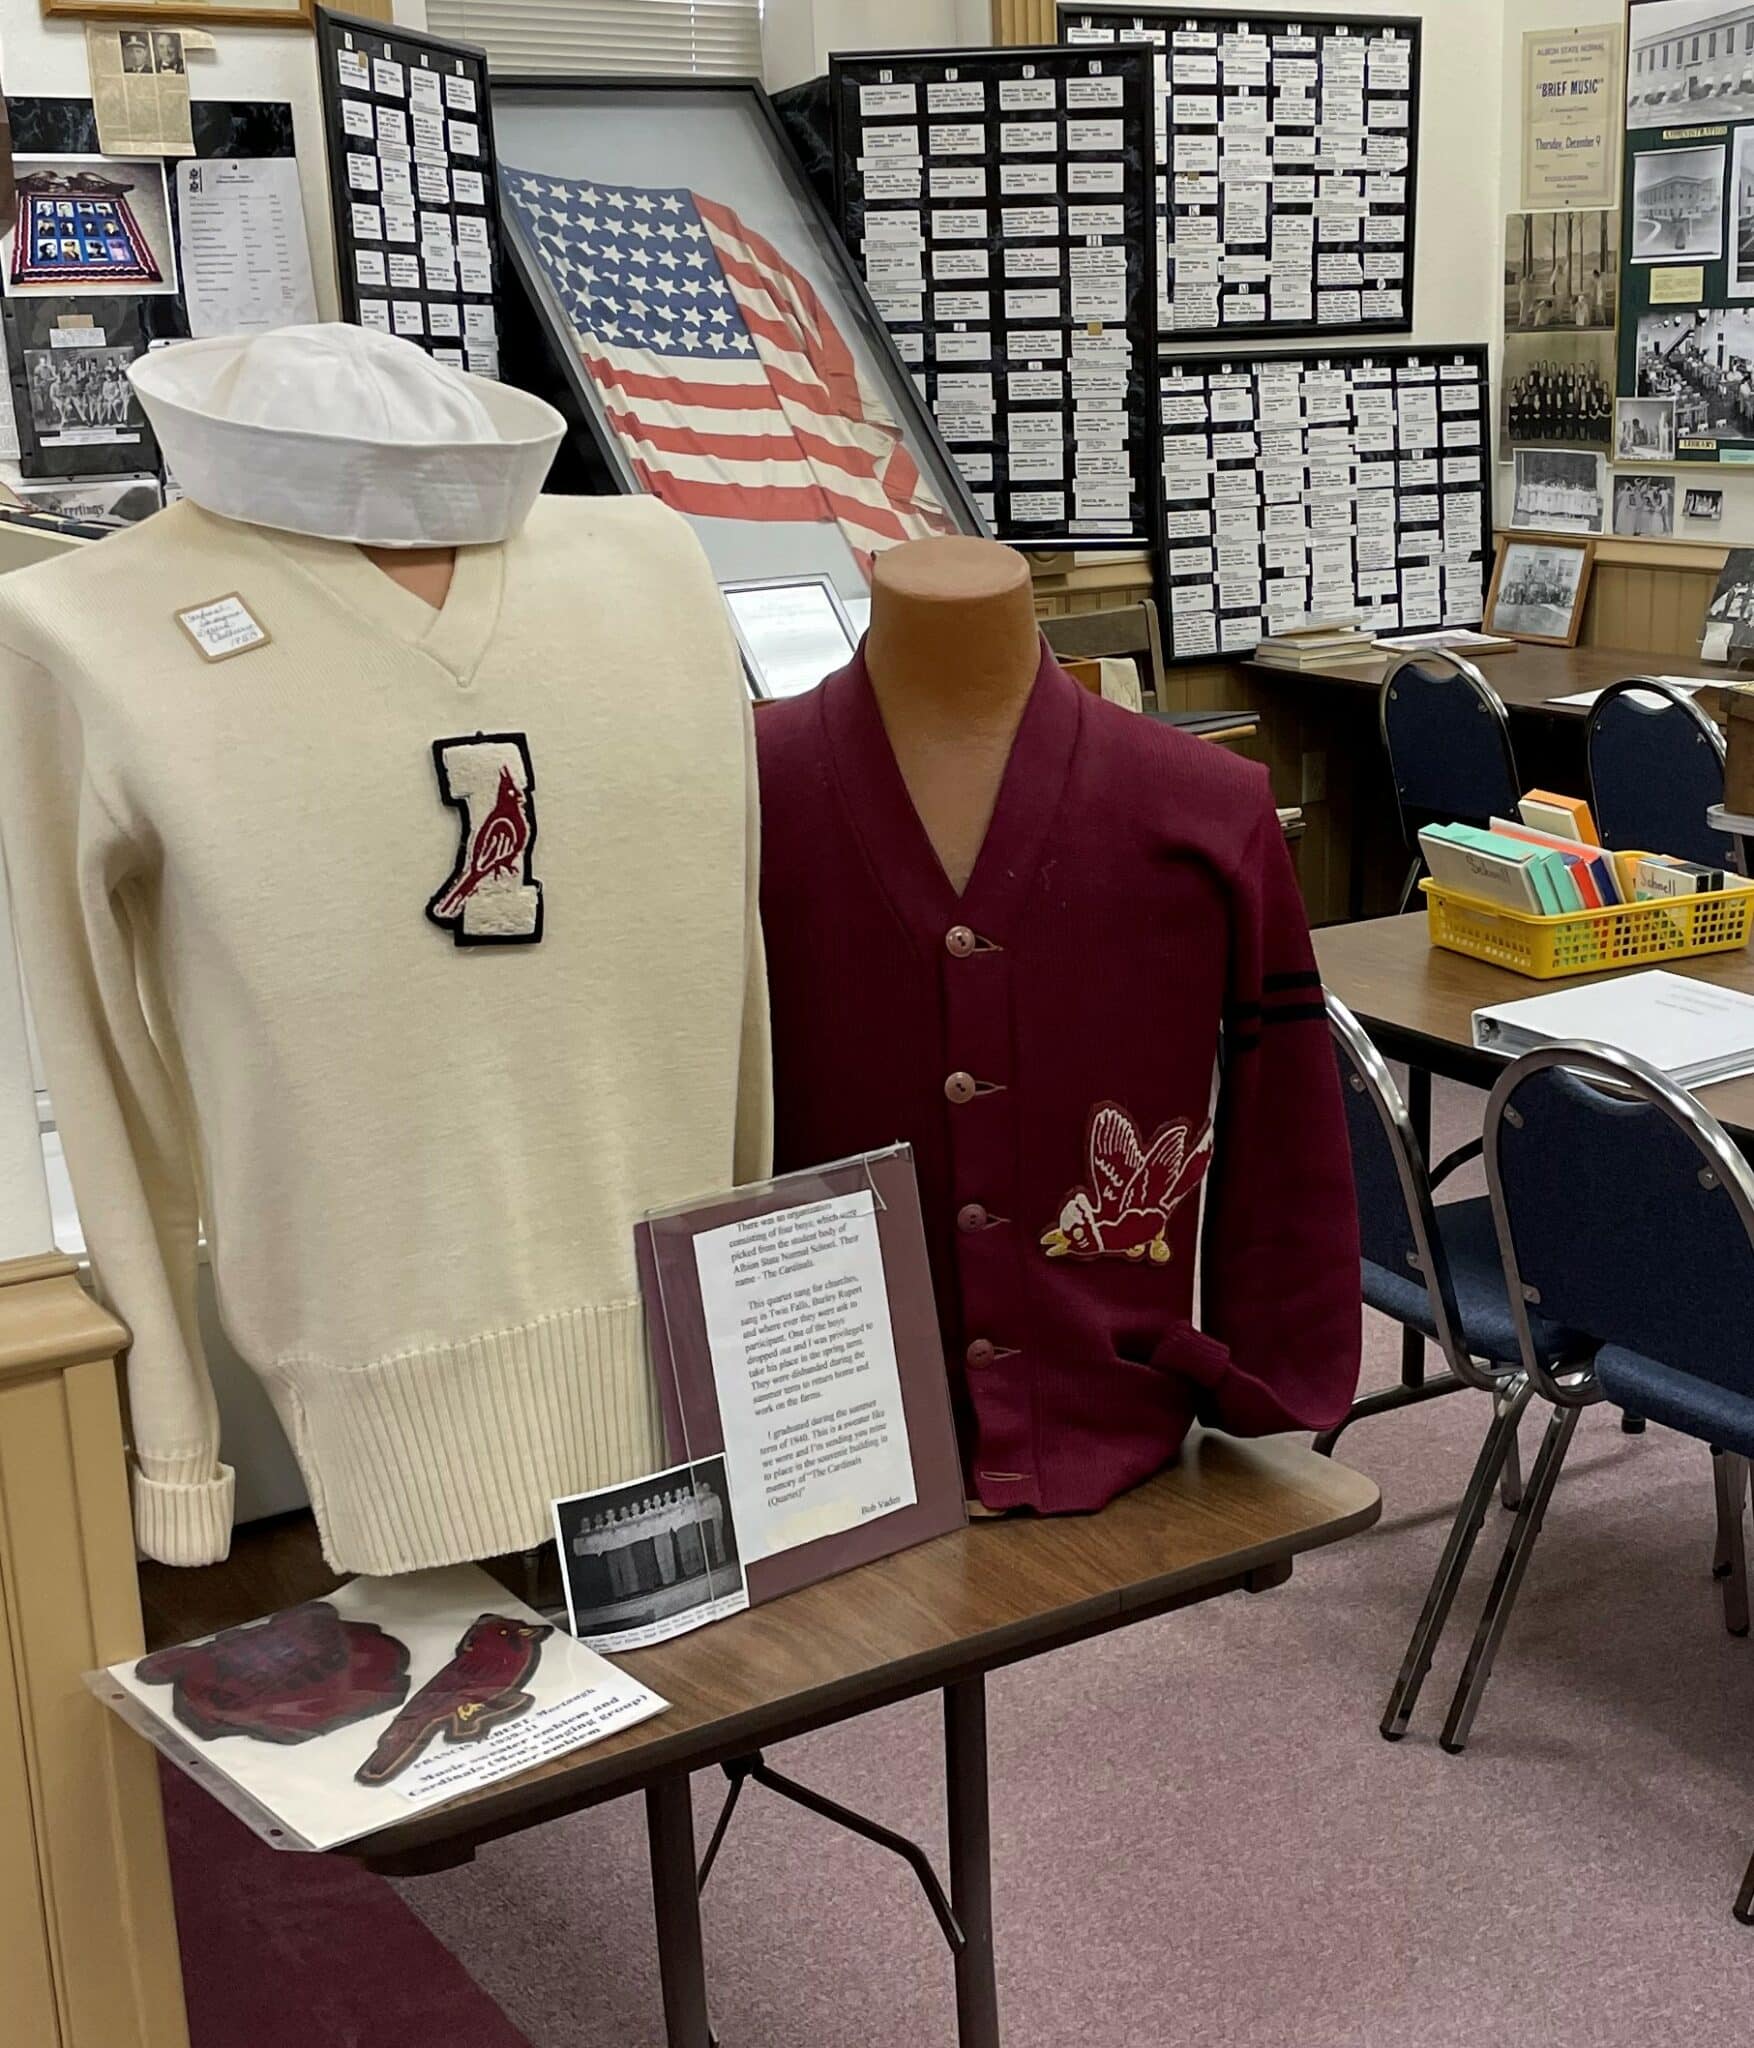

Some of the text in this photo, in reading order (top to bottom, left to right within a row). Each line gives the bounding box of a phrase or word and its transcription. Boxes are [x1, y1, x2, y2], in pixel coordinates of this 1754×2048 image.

[1561, 46, 1579, 54] STATE
[1536, 78, 1604, 97] "BRIEF MUSIC"
[1536, 135, 1601, 151] Thursday, December 9
[730, 1246, 756, 1263] picked
[757, 1243, 776, 1253] from
[776, 1239, 789, 1248] the
[817, 1227, 835, 1238] body
[838, 1222, 846, 1233] of
[737, 1221, 758, 1232] There
[760, 1217, 774, 1225] was
[767, 1227, 776, 1237] of
[816, 1213, 839, 1224] which
[760, 1256, 779, 1266] State
[780, 1246, 809, 1260] Normal
[734, 1275, 755, 1287] name
[762, 1269, 777, 1279] The
[837, 1285, 862, 1299] Rupert
[747, 1298, 765, 1310] This
[811, 1283, 823, 1292] for
[742, 1300, 857, 1339] and where ever they were ask to
[787, 1329, 804, 1339] One
[804, 1324, 813, 1334] of
[814, 1323, 826, 1332] the
[826, 1317, 845, 1328] boys
[746, 1348, 778, 1365] dropped
[779, 1345, 792, 1355] out
[793, 1339, 807, 1352] and
[812, 1336, 827, 1344] was
[828, 1322, 864, 1342] privileged
[865, 1321, 873, 1330] to
[748, 1367, 764, 1378] take
[765, 1364, 777, 1372] his
[778, 1357, 798, 1370] place
[800, 1354, 808, 1362] in
[808, 1351, 820, 1360] the
[822, 1344, 845, 1356] spring
[750, 1350, 865, 1390] They were disbanded during the
[752, 1388, 782, 1404] summer
[783, 1383, 801, 1394] term
[811, 1373, 833, 1386] return
[833, 1367, 854, 1379] home
[855, 1360, 869, 1372] and
[754, 1404, 774, 1416] work
[775, 1401, 785, 1410] on
[786, 1397, 798, 1406] the
[773, 1418, 809, 1440] graduated
[810, 1412, 835, 1426] during
[835, 1408, 847, 1418] the
[848, 1399, 877, 1414] summer
[759, 1444, 777, 1455] term
[778, 1438, 787, 1449] of
[811, 1428, 828, 1438] This
[871, 1409, 885, 1419] like
[761, 1458, 773, 1467] we
[795, 1445, 809, 1457] and
[824, 1433, 852, 1448] sending
[854, 1429, 867, 1439] you
[763, 1472, 771, 1480] to
[773, 1466, 793, 1480] place
[803, 1458, 815, 1468] the
[848, 1438, 879, 1453] building
[765, 1479, 796, 1494] memory
[797, 1472, 806, 1483] of
[826, 1456, 862, 1474] Cardinals
[860, 1503, 876, 1515] Bob
[408, 1694, 648, 1797] Cardinals (Men's singing group)
[420, 1696, 620, 1781] Music sweater emblem and
[479, 1728, 601, 1780] sweater emblem
